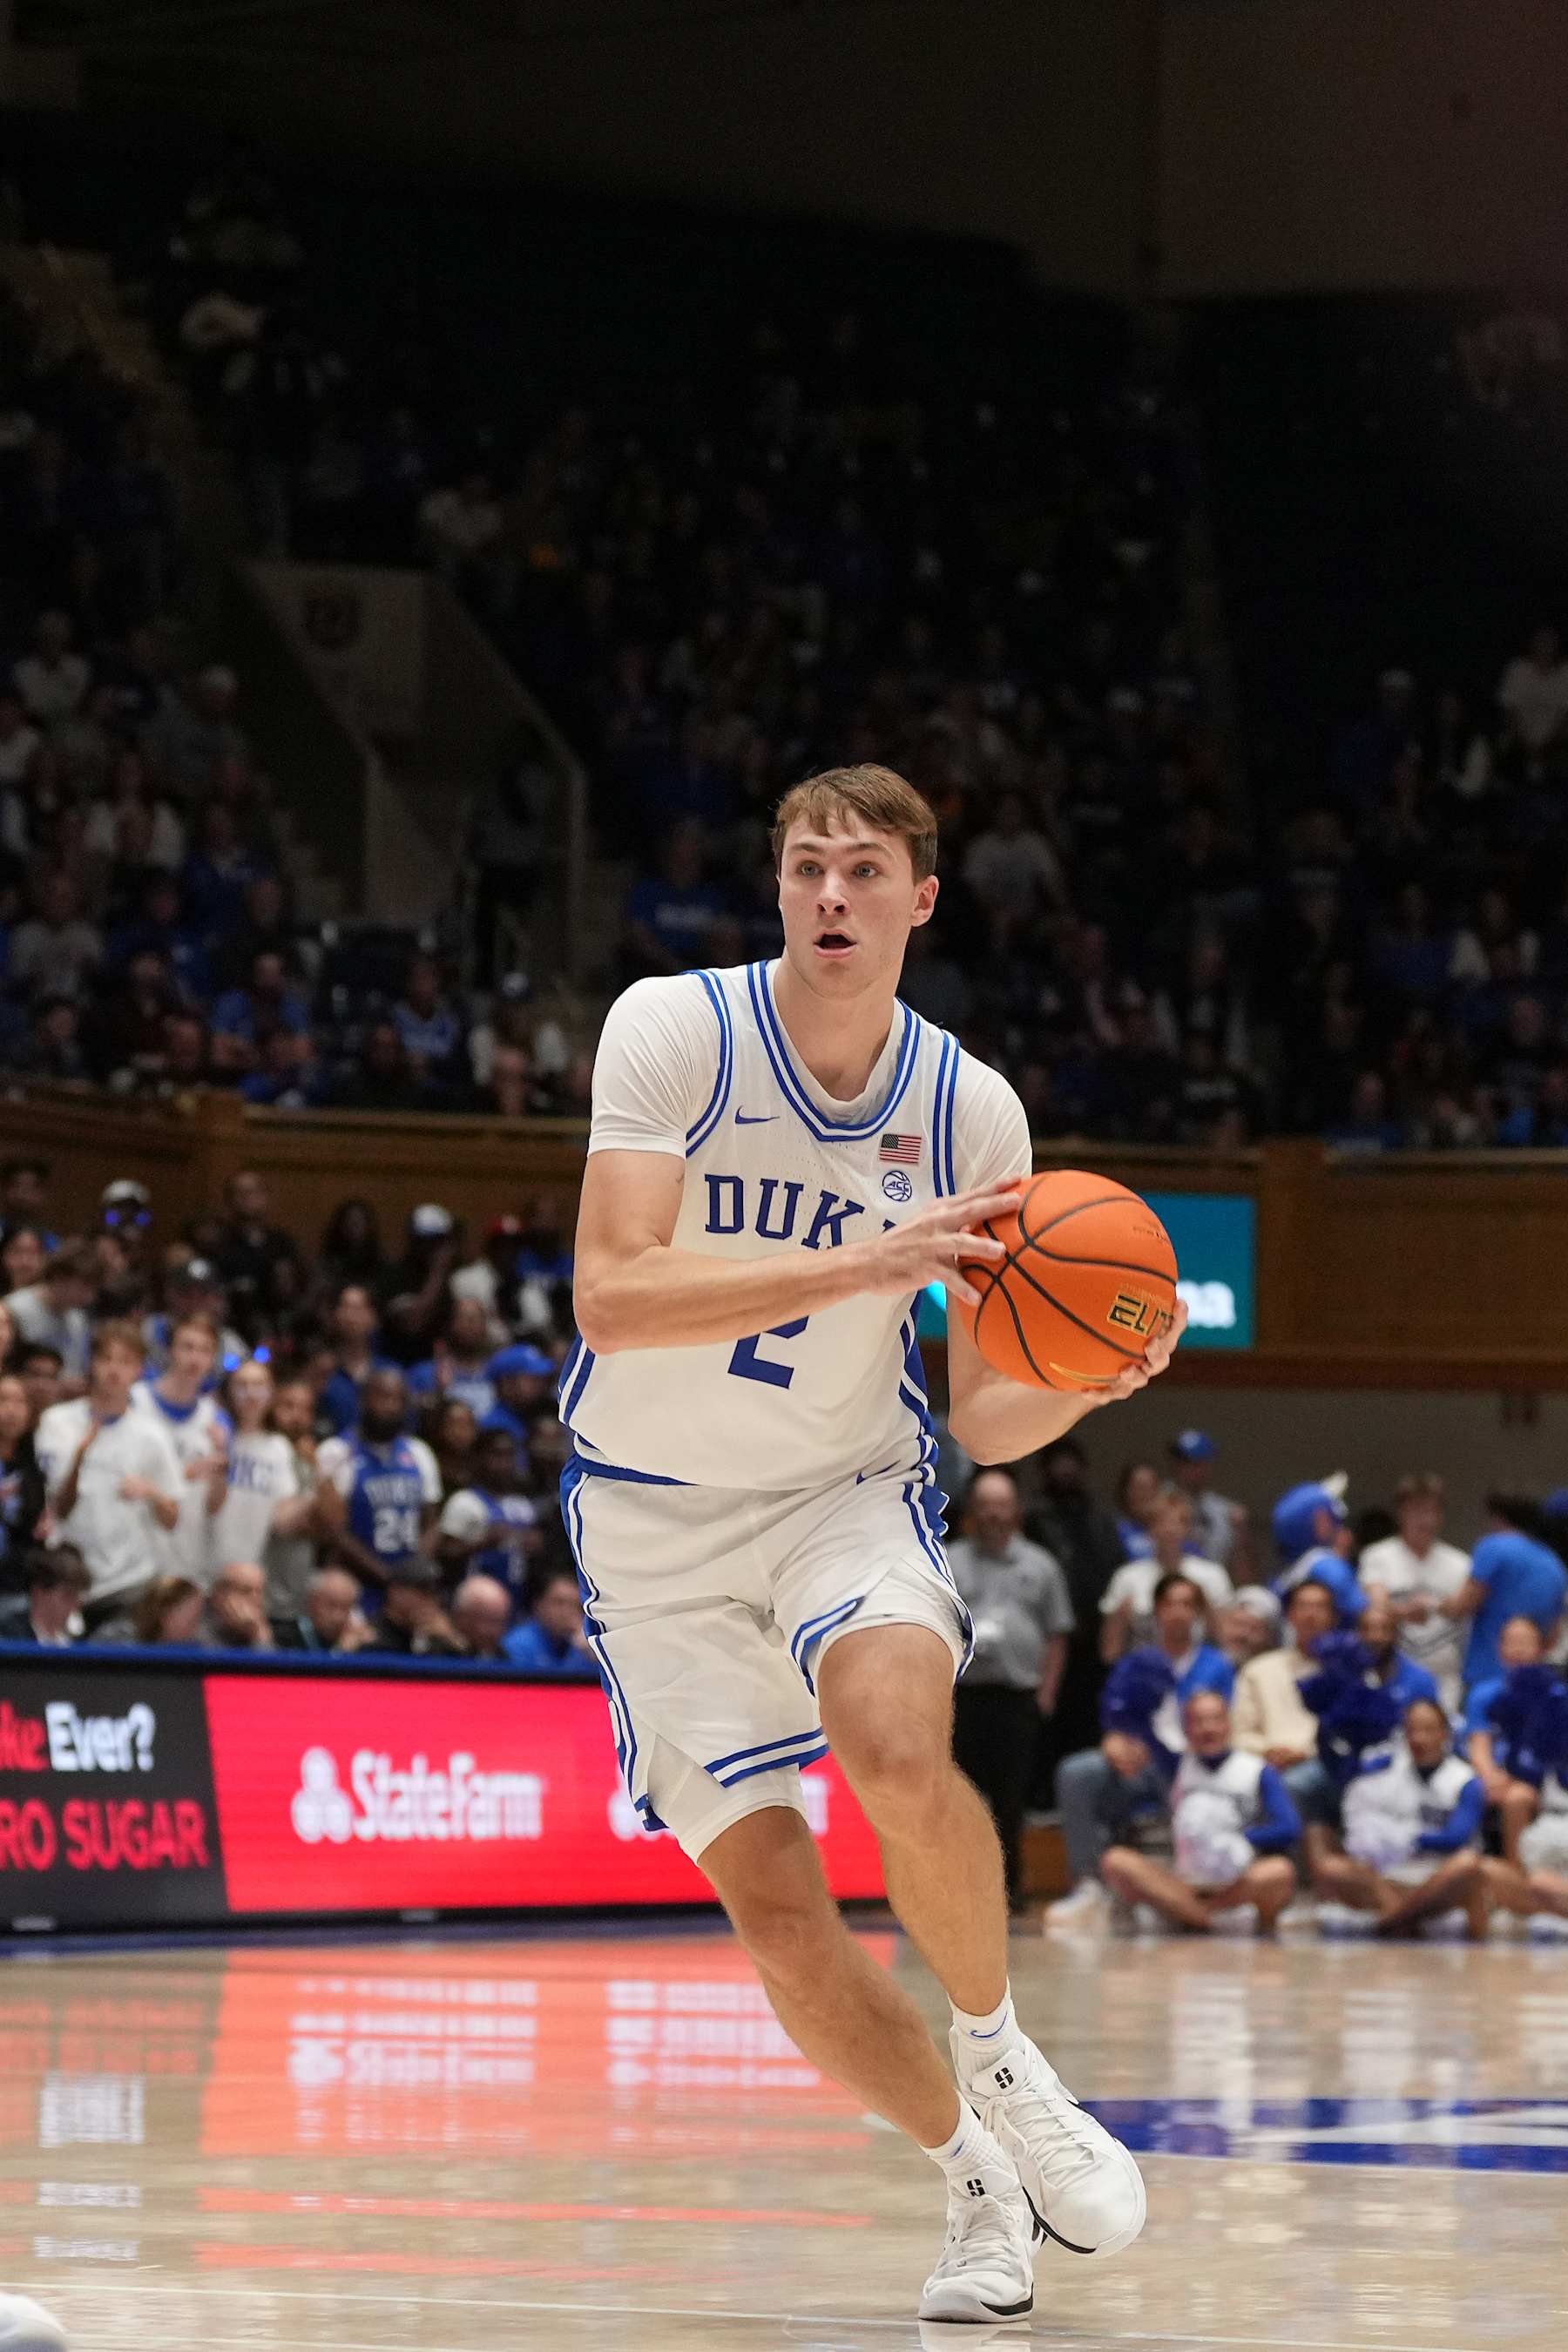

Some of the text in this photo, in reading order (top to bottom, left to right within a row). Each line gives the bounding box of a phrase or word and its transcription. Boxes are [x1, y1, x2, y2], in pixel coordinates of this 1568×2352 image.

[704, 1173, 897, 1251] DUK
[1108, 1294, 1174, 1339] ELIT
[46, 1701, 155, 1772] Ever?
[62, 1797, 211, 1870] SUGAR
